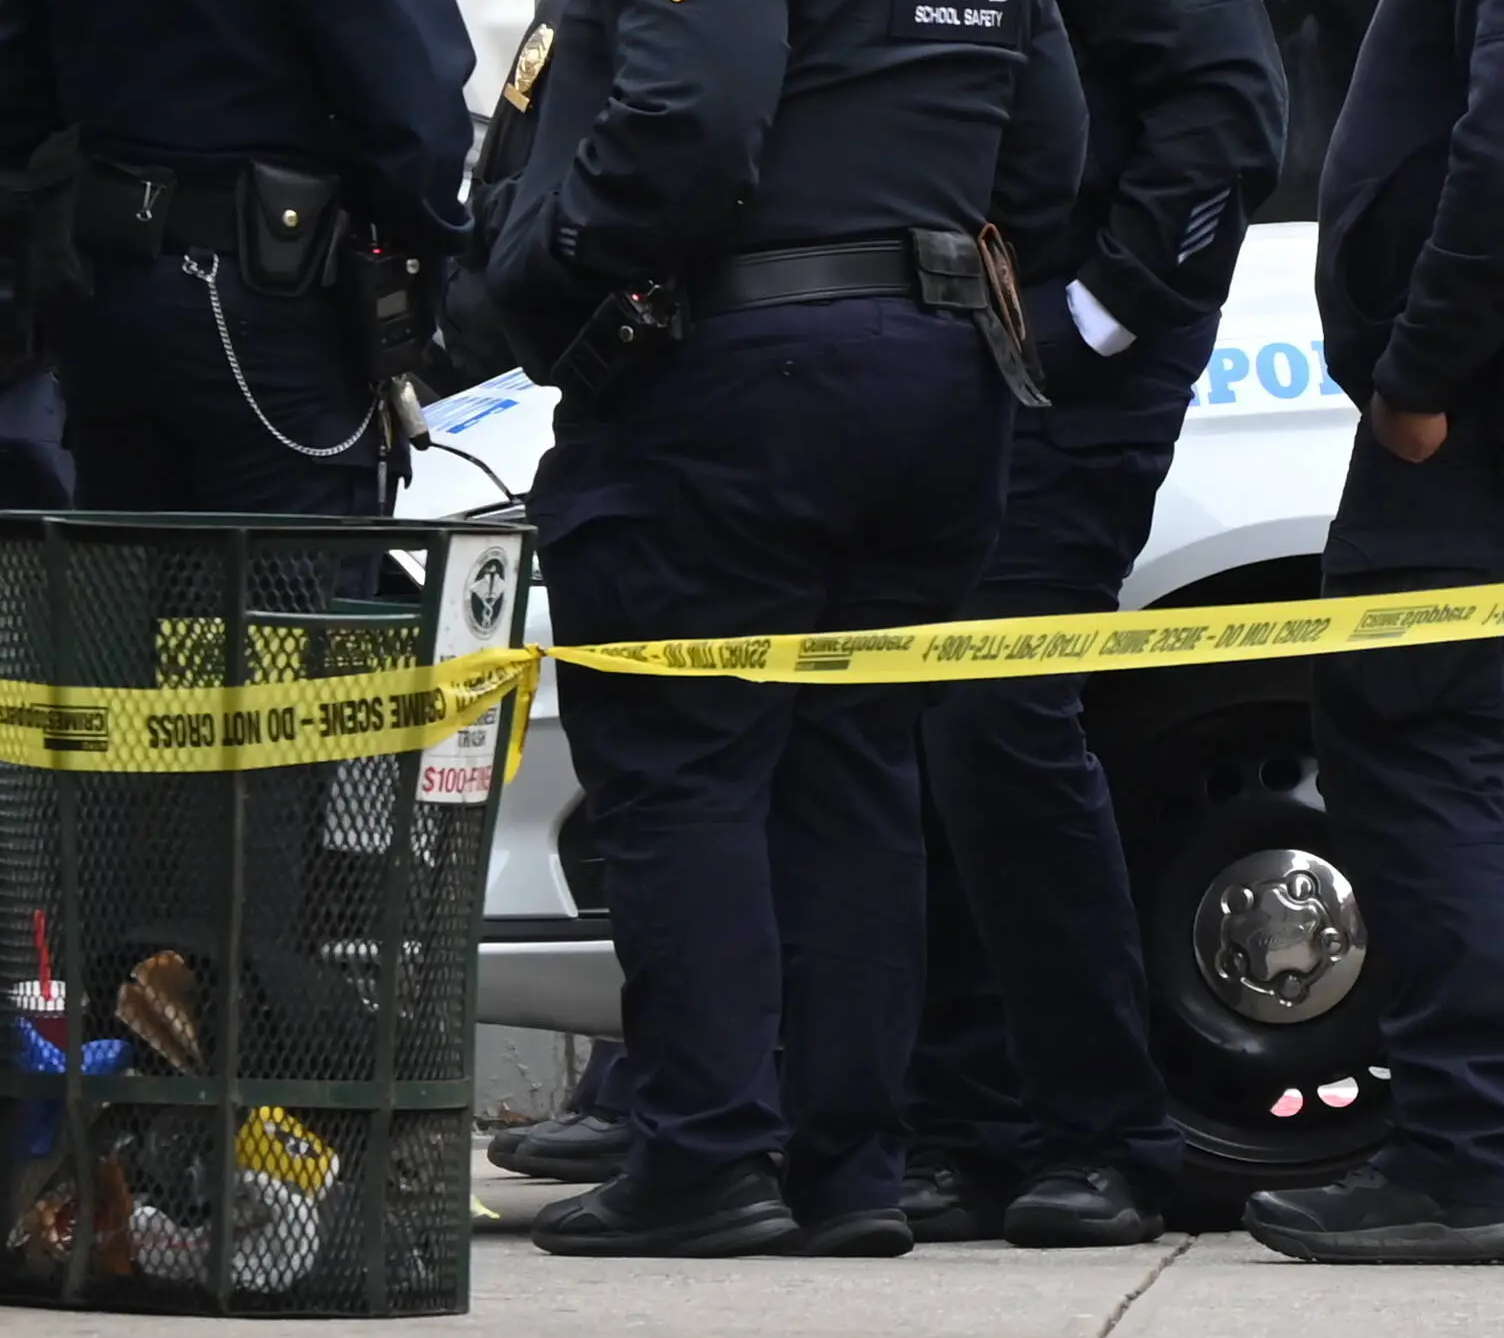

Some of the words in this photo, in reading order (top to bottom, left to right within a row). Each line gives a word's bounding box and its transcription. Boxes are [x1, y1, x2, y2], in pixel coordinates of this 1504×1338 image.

[914, 5, 961, 25] SCHOOL
[964, 9, 1003, 27] SAFETY
[267, 707, 294, 741] DO
[319, 697, 384, 738] SCENE
[390, 687, 446, 729] CRIME
[148, 712, 215, 749] CROSS
[222, 710, 261, 747] NOT
[422, 765, 466, 794] $100
